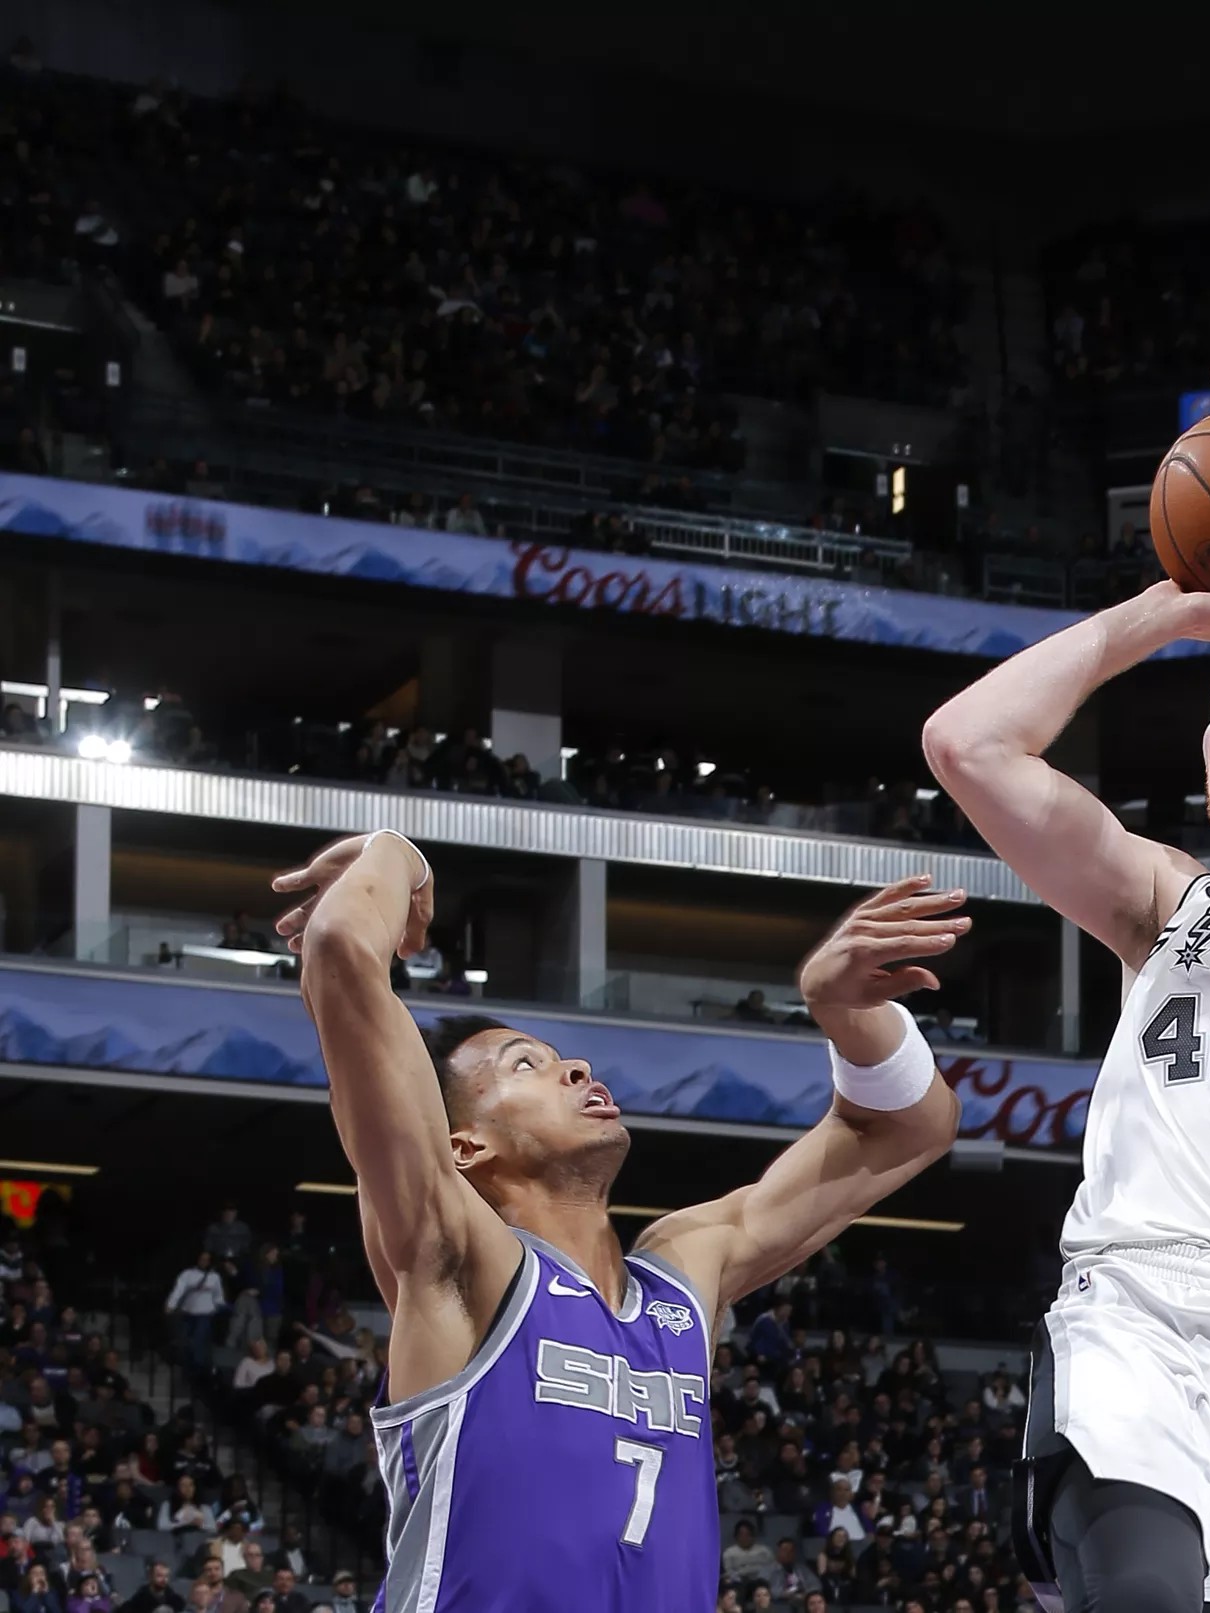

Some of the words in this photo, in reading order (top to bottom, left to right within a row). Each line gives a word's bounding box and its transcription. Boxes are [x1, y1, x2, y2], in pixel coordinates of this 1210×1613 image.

[511, 542, 686, 615] Coors
[535, 1338, 705, 1438] SAC
[614, 1436, 666, 1549] 7
